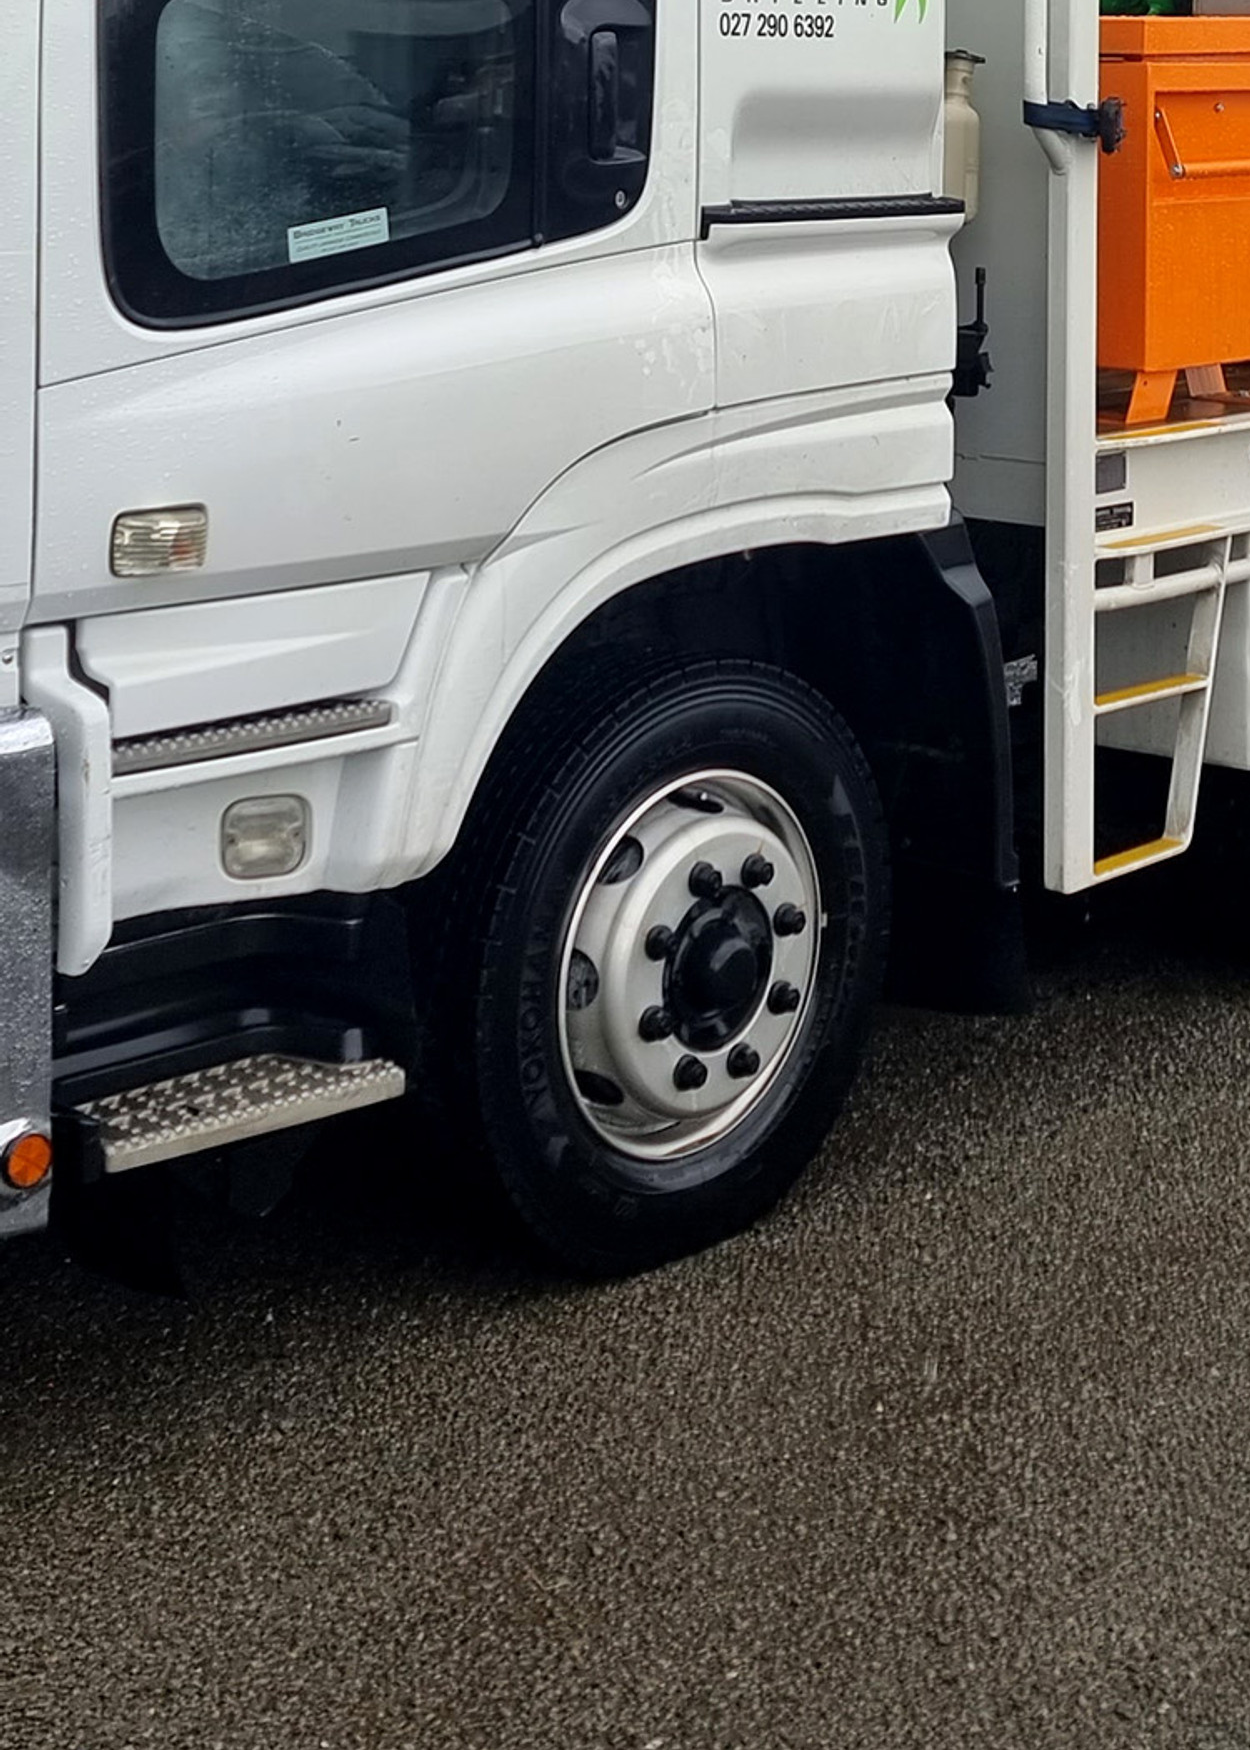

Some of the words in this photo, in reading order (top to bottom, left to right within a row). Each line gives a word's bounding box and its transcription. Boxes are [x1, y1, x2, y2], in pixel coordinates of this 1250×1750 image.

[719, 13, 751, 37] 027
[757, 14, 788, 38] 290
[794, 15, 835, 38] 6392
